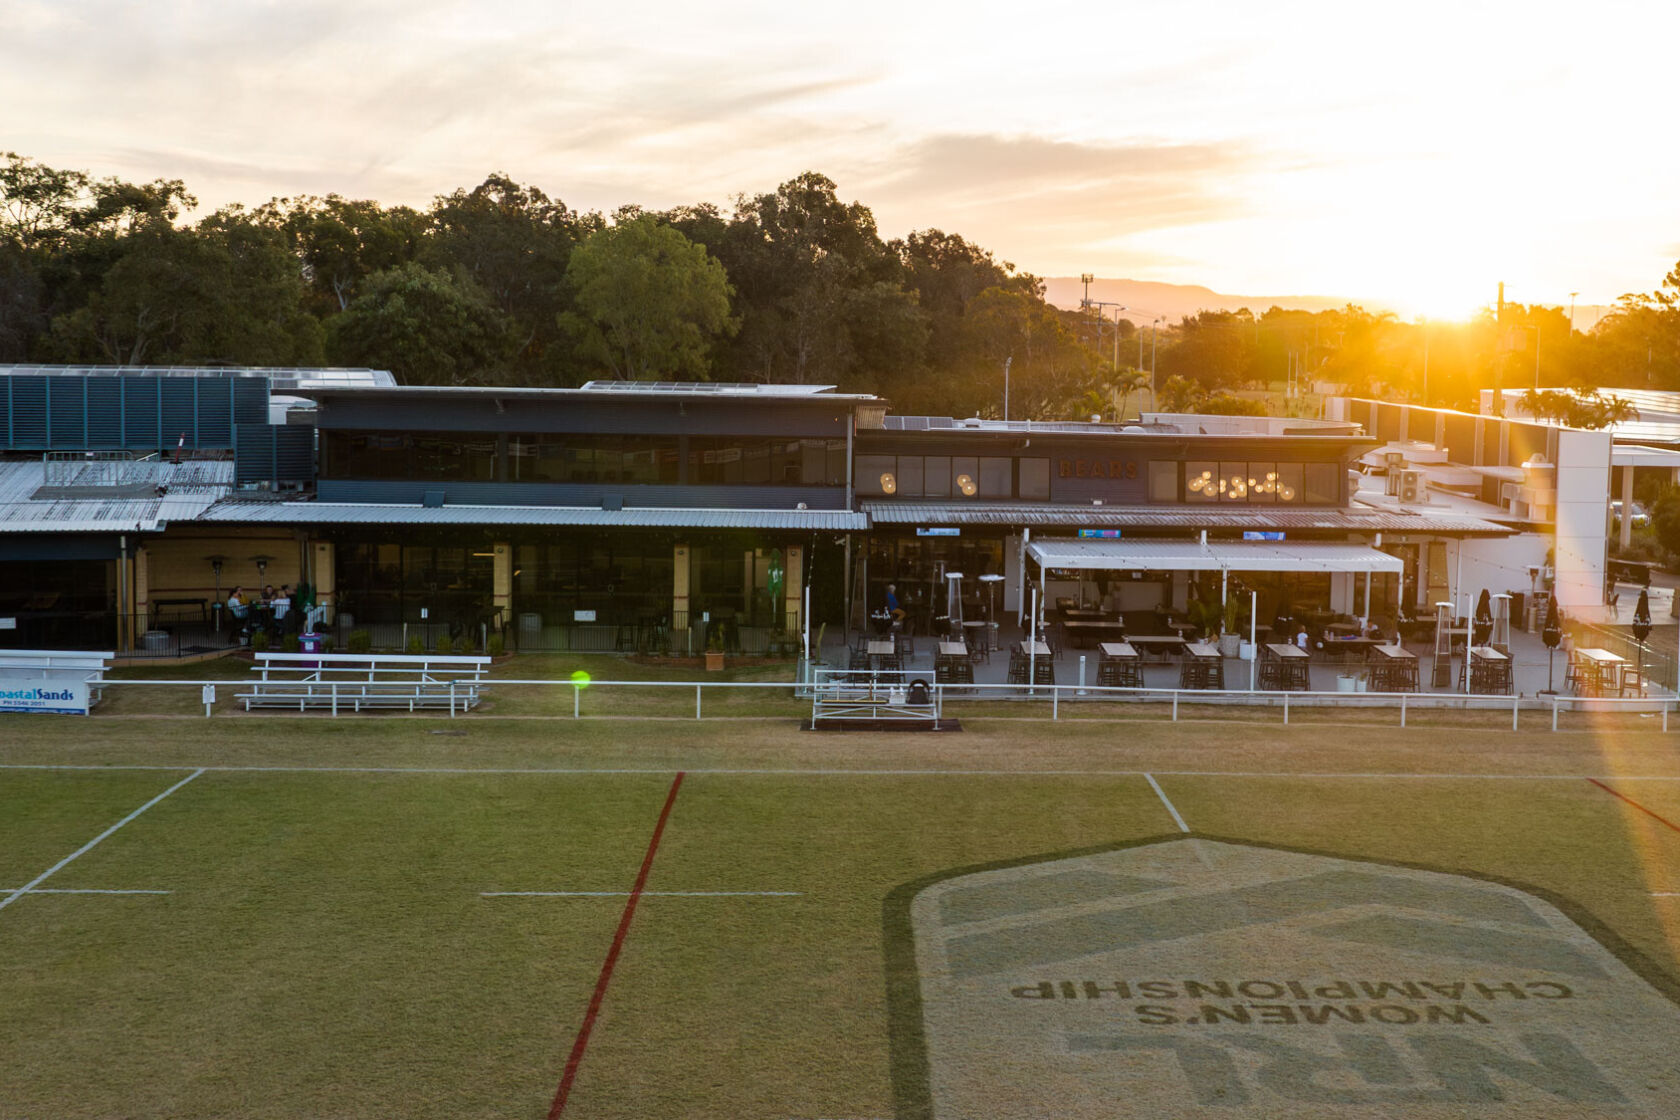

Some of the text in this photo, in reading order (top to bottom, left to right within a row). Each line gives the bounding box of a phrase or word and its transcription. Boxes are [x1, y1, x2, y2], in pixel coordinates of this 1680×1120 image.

[1059, 459, 1138, 479] BEARS
[1011, 981, 1574, 1000] CHAMPIONSHIP
[1134, 1004, 1491, 1025] WOMEN'S
